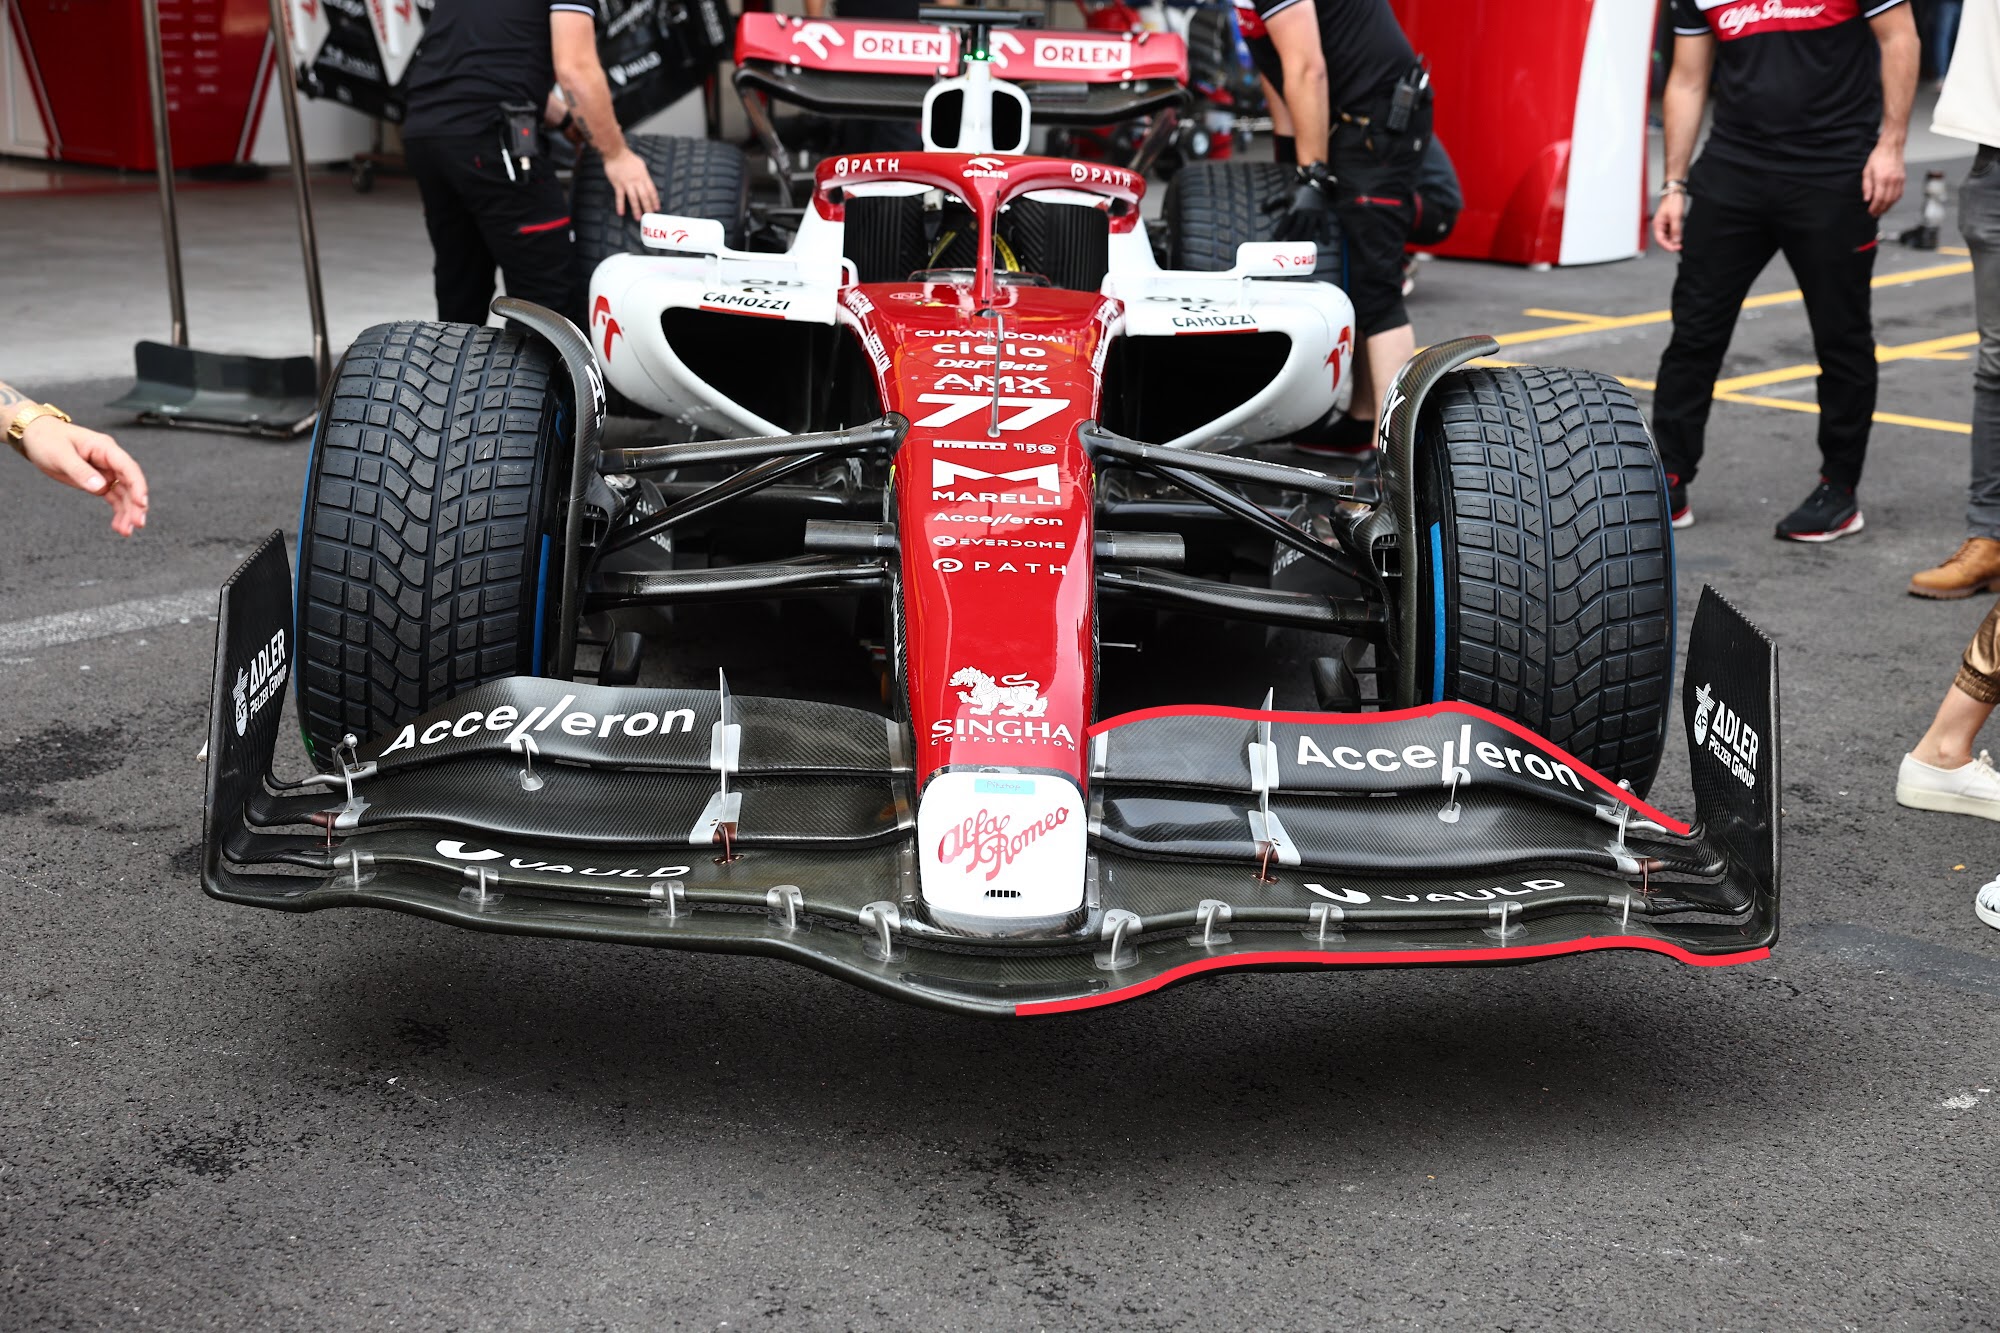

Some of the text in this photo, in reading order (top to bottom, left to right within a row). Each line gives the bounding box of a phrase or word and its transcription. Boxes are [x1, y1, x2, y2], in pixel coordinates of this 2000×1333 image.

[1718, 0, 1826, 35] Alfa Romeo
[862, 38, 943, 58] ORLEN
[1042, 46, 1122, 63] ORLEN
[850, 158, 899, 174] PATH
[963, 169, 1008, 180] ORLEN
[1090, 169, 1131, 187] PATH
[643, 226, 667, 239] RLEN
[703, 292, 790, 310] CAMOZZI
[1172, 314, 1256, 327] CAMOZZI
[1002, 331, 1064, 343] DOMI
[932, 342, 1046, 357] cielo
[933, 358, 1048, 371] DRF Bets
[934, 373, 1051, 390] AMX
[914, 394, 1071, 431] 77
[933, 440, 1007, 450] PIRELLI
[932, 491, 1062, 506] MARELLI
[933, 512, 1064, 527] Accelleron
[959, 538, 1066, 549] EVERDOME
[974, 561, 1067, 576] PATH
[250, 628, 286, 697] ADLER
[250, 686, 270, 720] PELZER
[379, 695, 696, 757] Accelleron
[931, 718, 1075, 744] SINGHA
[931, 736, 1075, 751] CORPORATION
[1711, 700, 1759, 771] ADLER
[1297, 724, 1585, 792] Accelleron
[1708, 733, 1756, 790] PELZER GROUP
[938, 808, 1010, 873] Alfa
[978, 806, 1069, 881] Romeo
[510, 858, 691, 878] VAULD
[1381, 879, 1566, 904] VAULD
